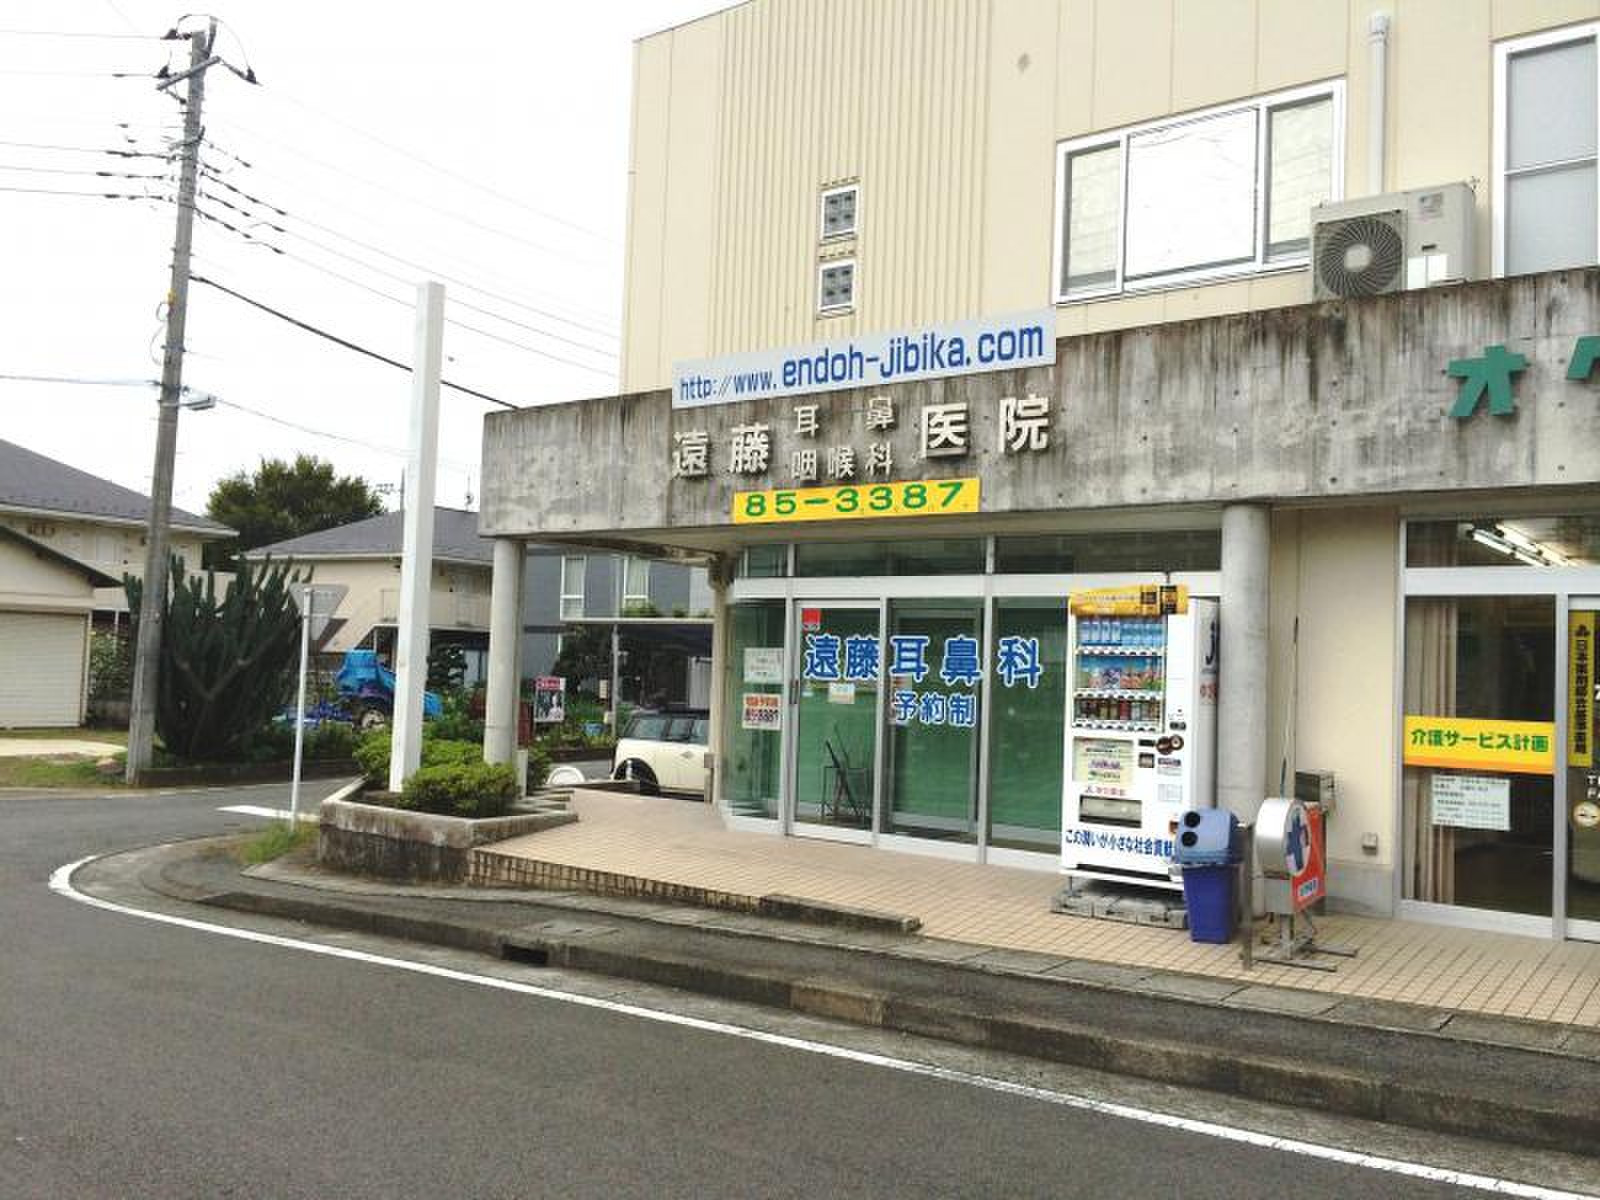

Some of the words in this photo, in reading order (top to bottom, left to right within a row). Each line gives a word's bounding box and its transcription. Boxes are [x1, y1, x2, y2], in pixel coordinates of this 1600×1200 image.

[793, 396, 895, 436] 耳鼻
[672, 423, 769, 478] 遠藤
[921, 397, 1050, 460] 医院
[791, 441, 894, 481] 咽喉科
[745, 482, 965, 517] 85-3387
[893, 691, 978, 728] 予約制
[1411, 728, 1549, 753] 介護サービス計画
